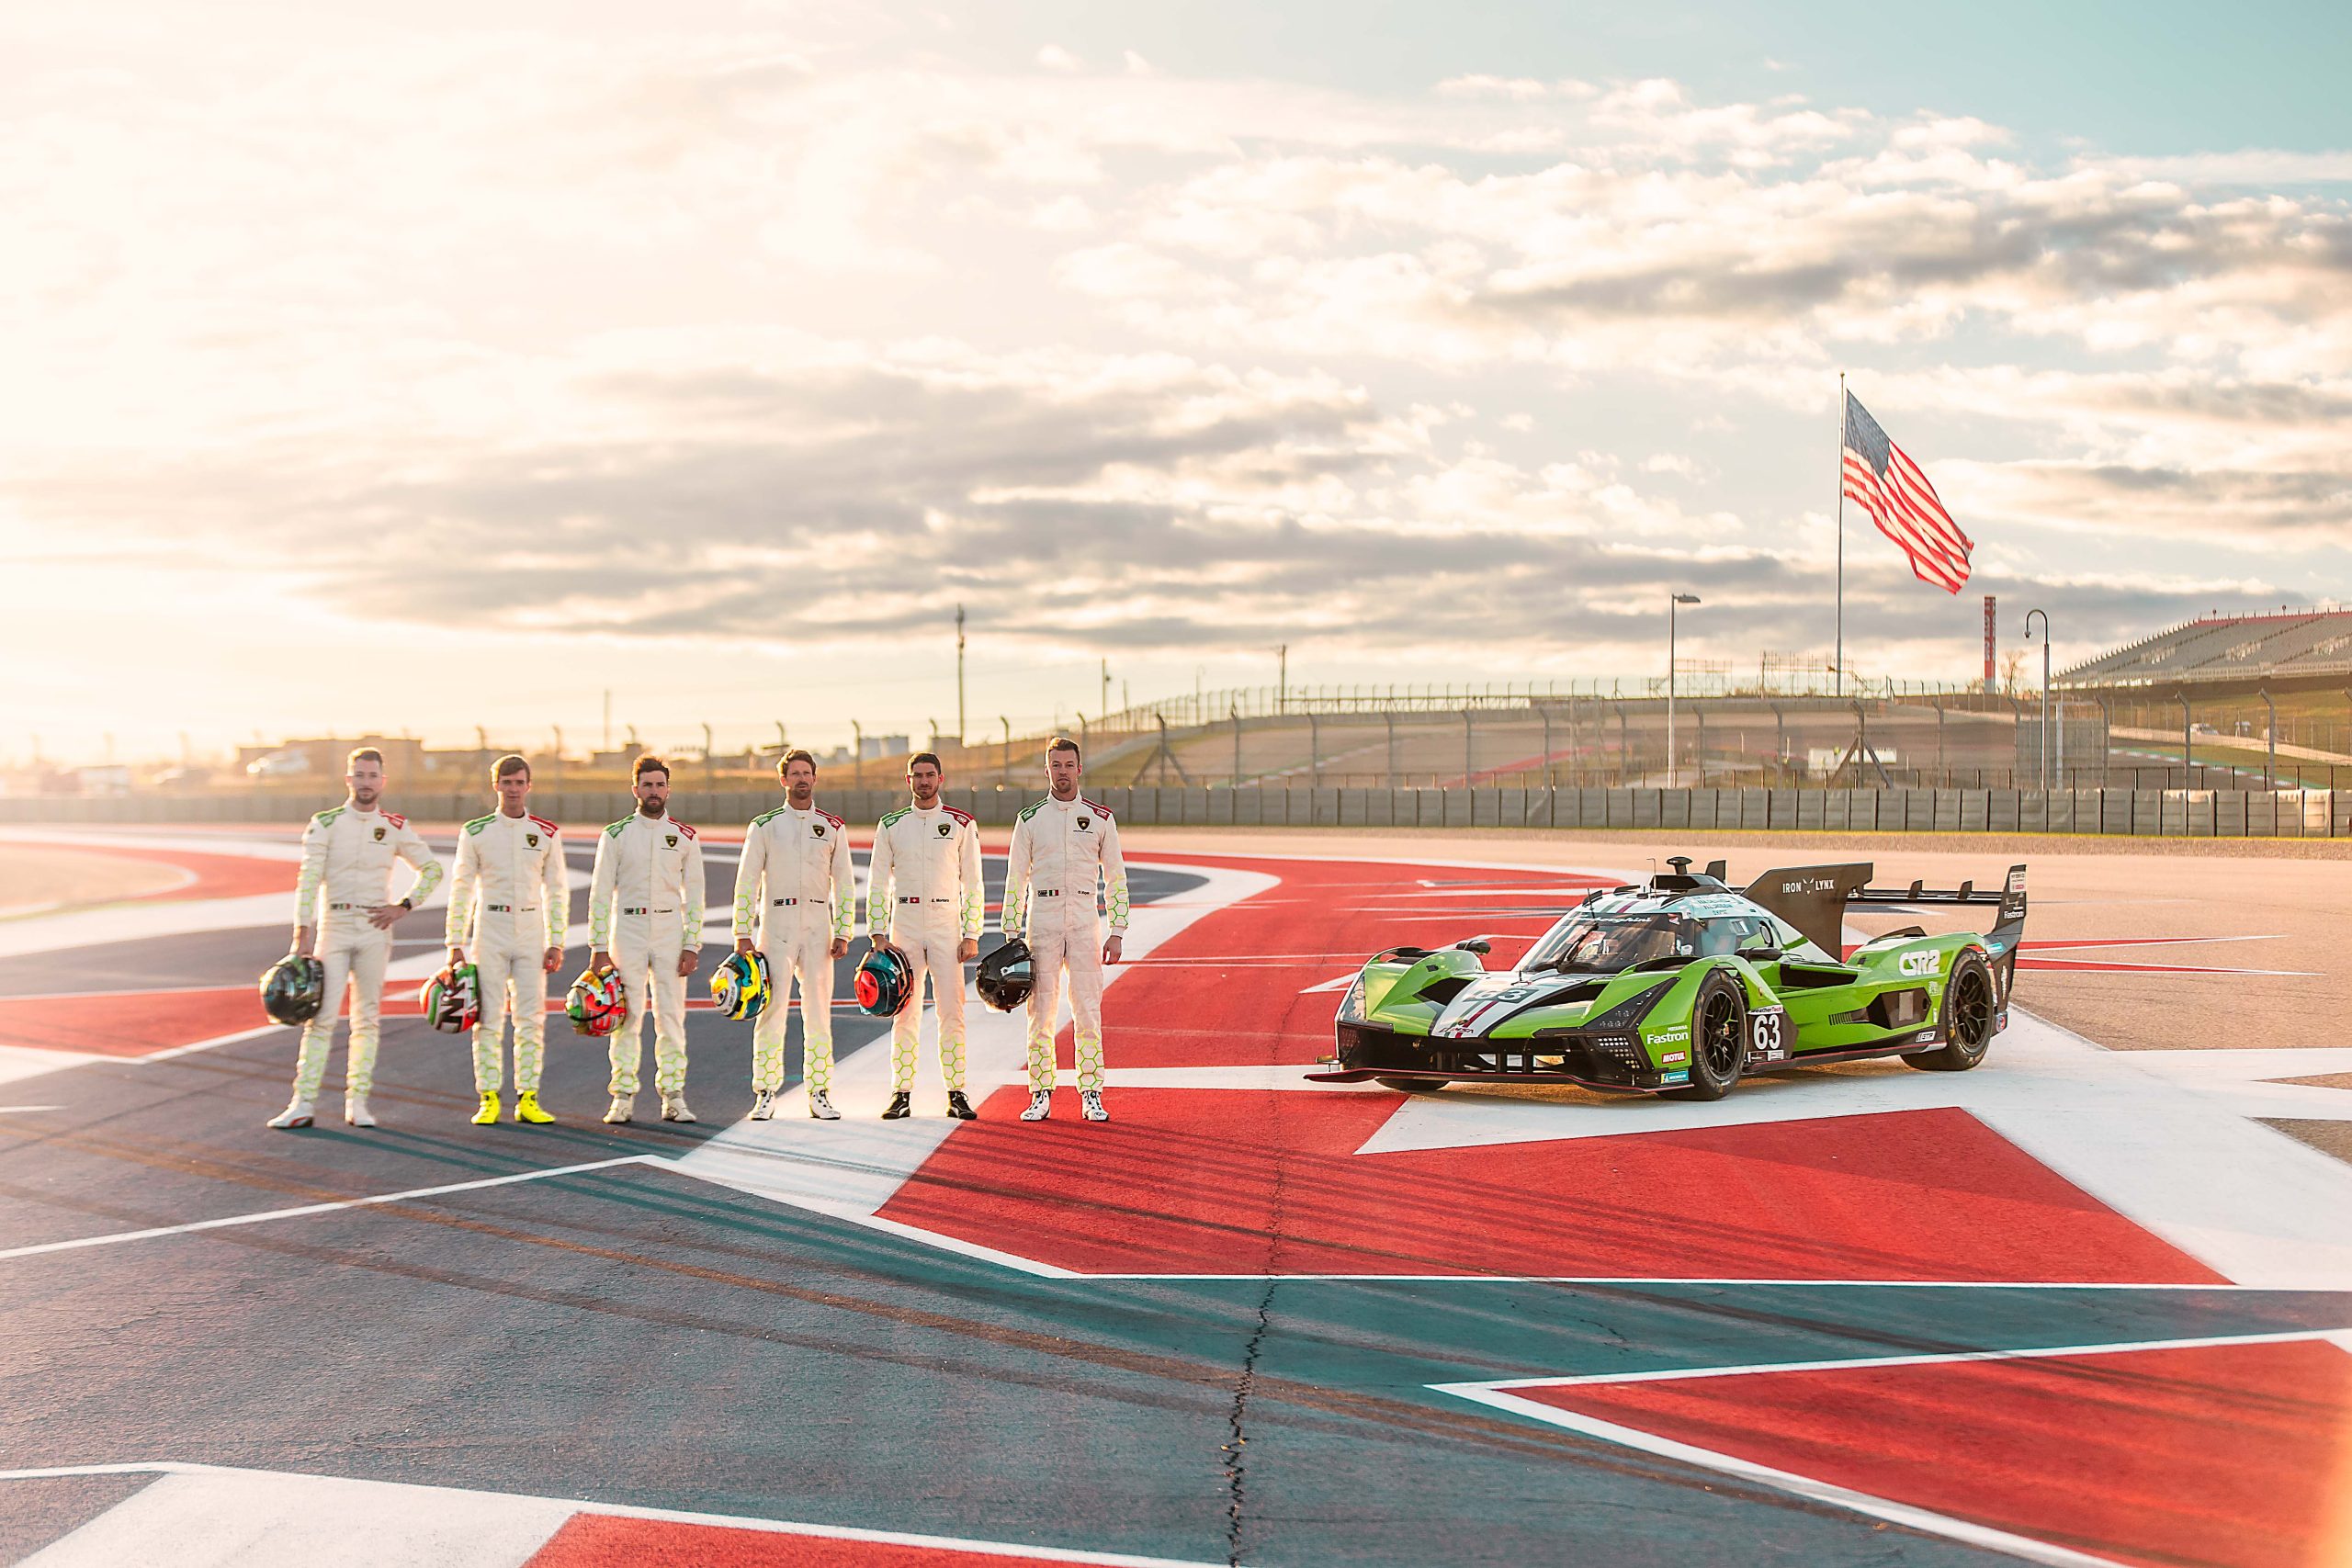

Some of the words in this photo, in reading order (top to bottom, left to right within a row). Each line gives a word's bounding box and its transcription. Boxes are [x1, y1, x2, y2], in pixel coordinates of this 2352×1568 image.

[1782, 882, 1802, 894] IRON
[1815, 879, 1834, 891] LYNX
[1899, 949, 1940, 976] CSR2
[1646, 1032, 1689, 1045] Fastron
[1753, 1014, 1781, 1050] 63
[1663, 1052, 1685, 1063] MOTUL
